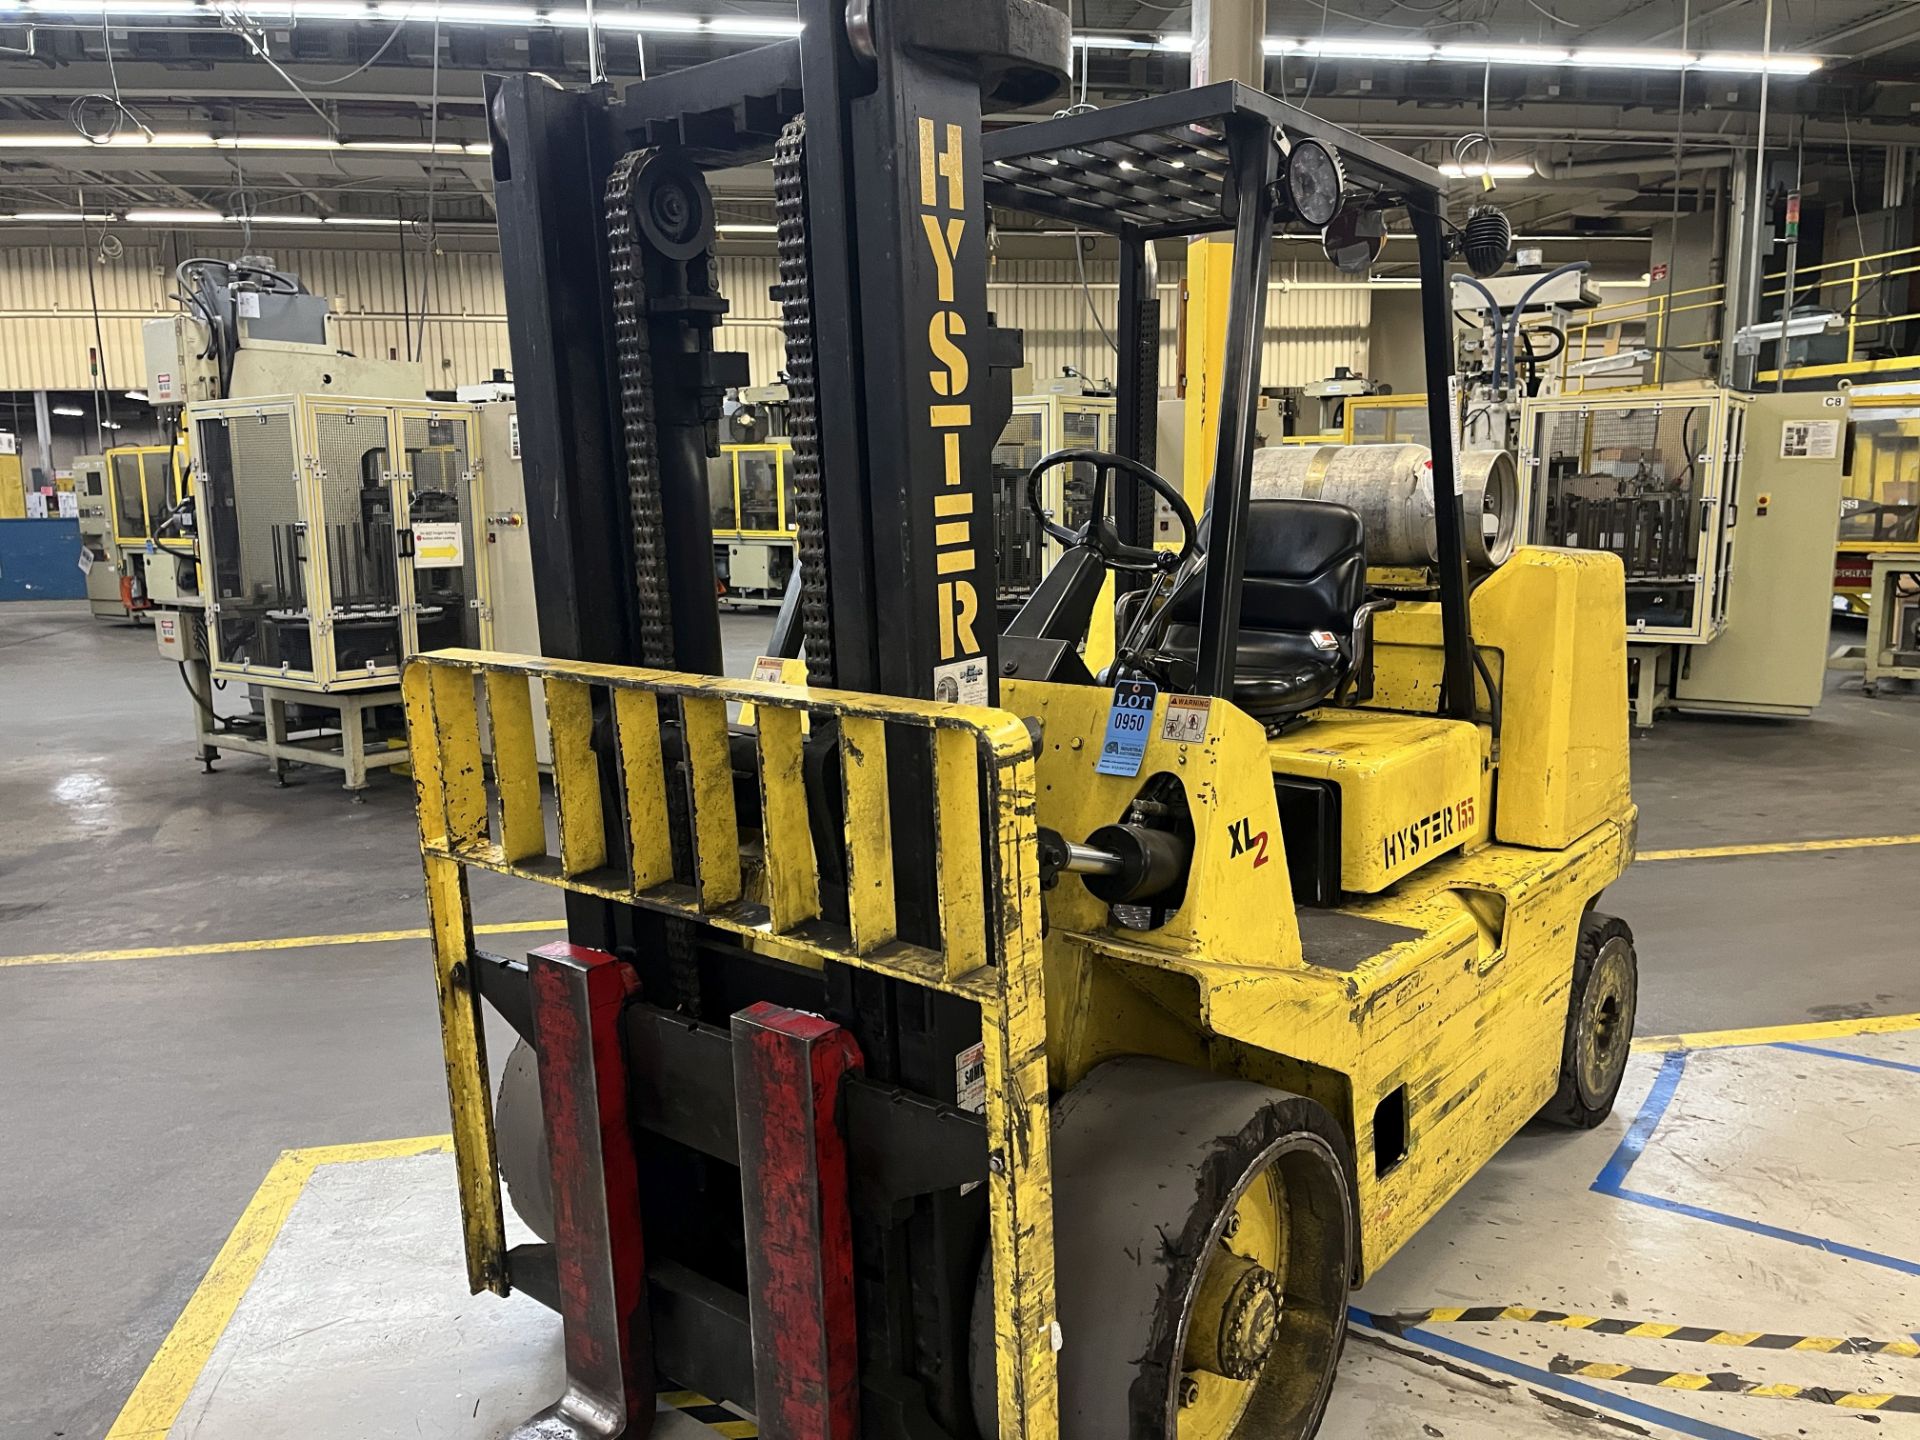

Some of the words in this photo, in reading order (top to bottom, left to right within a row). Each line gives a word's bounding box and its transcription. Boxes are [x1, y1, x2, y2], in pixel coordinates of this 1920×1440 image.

[919, 117, 980, 660] HYSTER
[1826, 397, 1842, 407] C8
[1117, 694, 1152, 709] LOT
[1179, 698, 1209, 707] WARNING
[1115, 713, 1144, 731] 0950
[1384, 806, 1454, 870] HYSTER
[1455, 796, 1475, 832] 155
